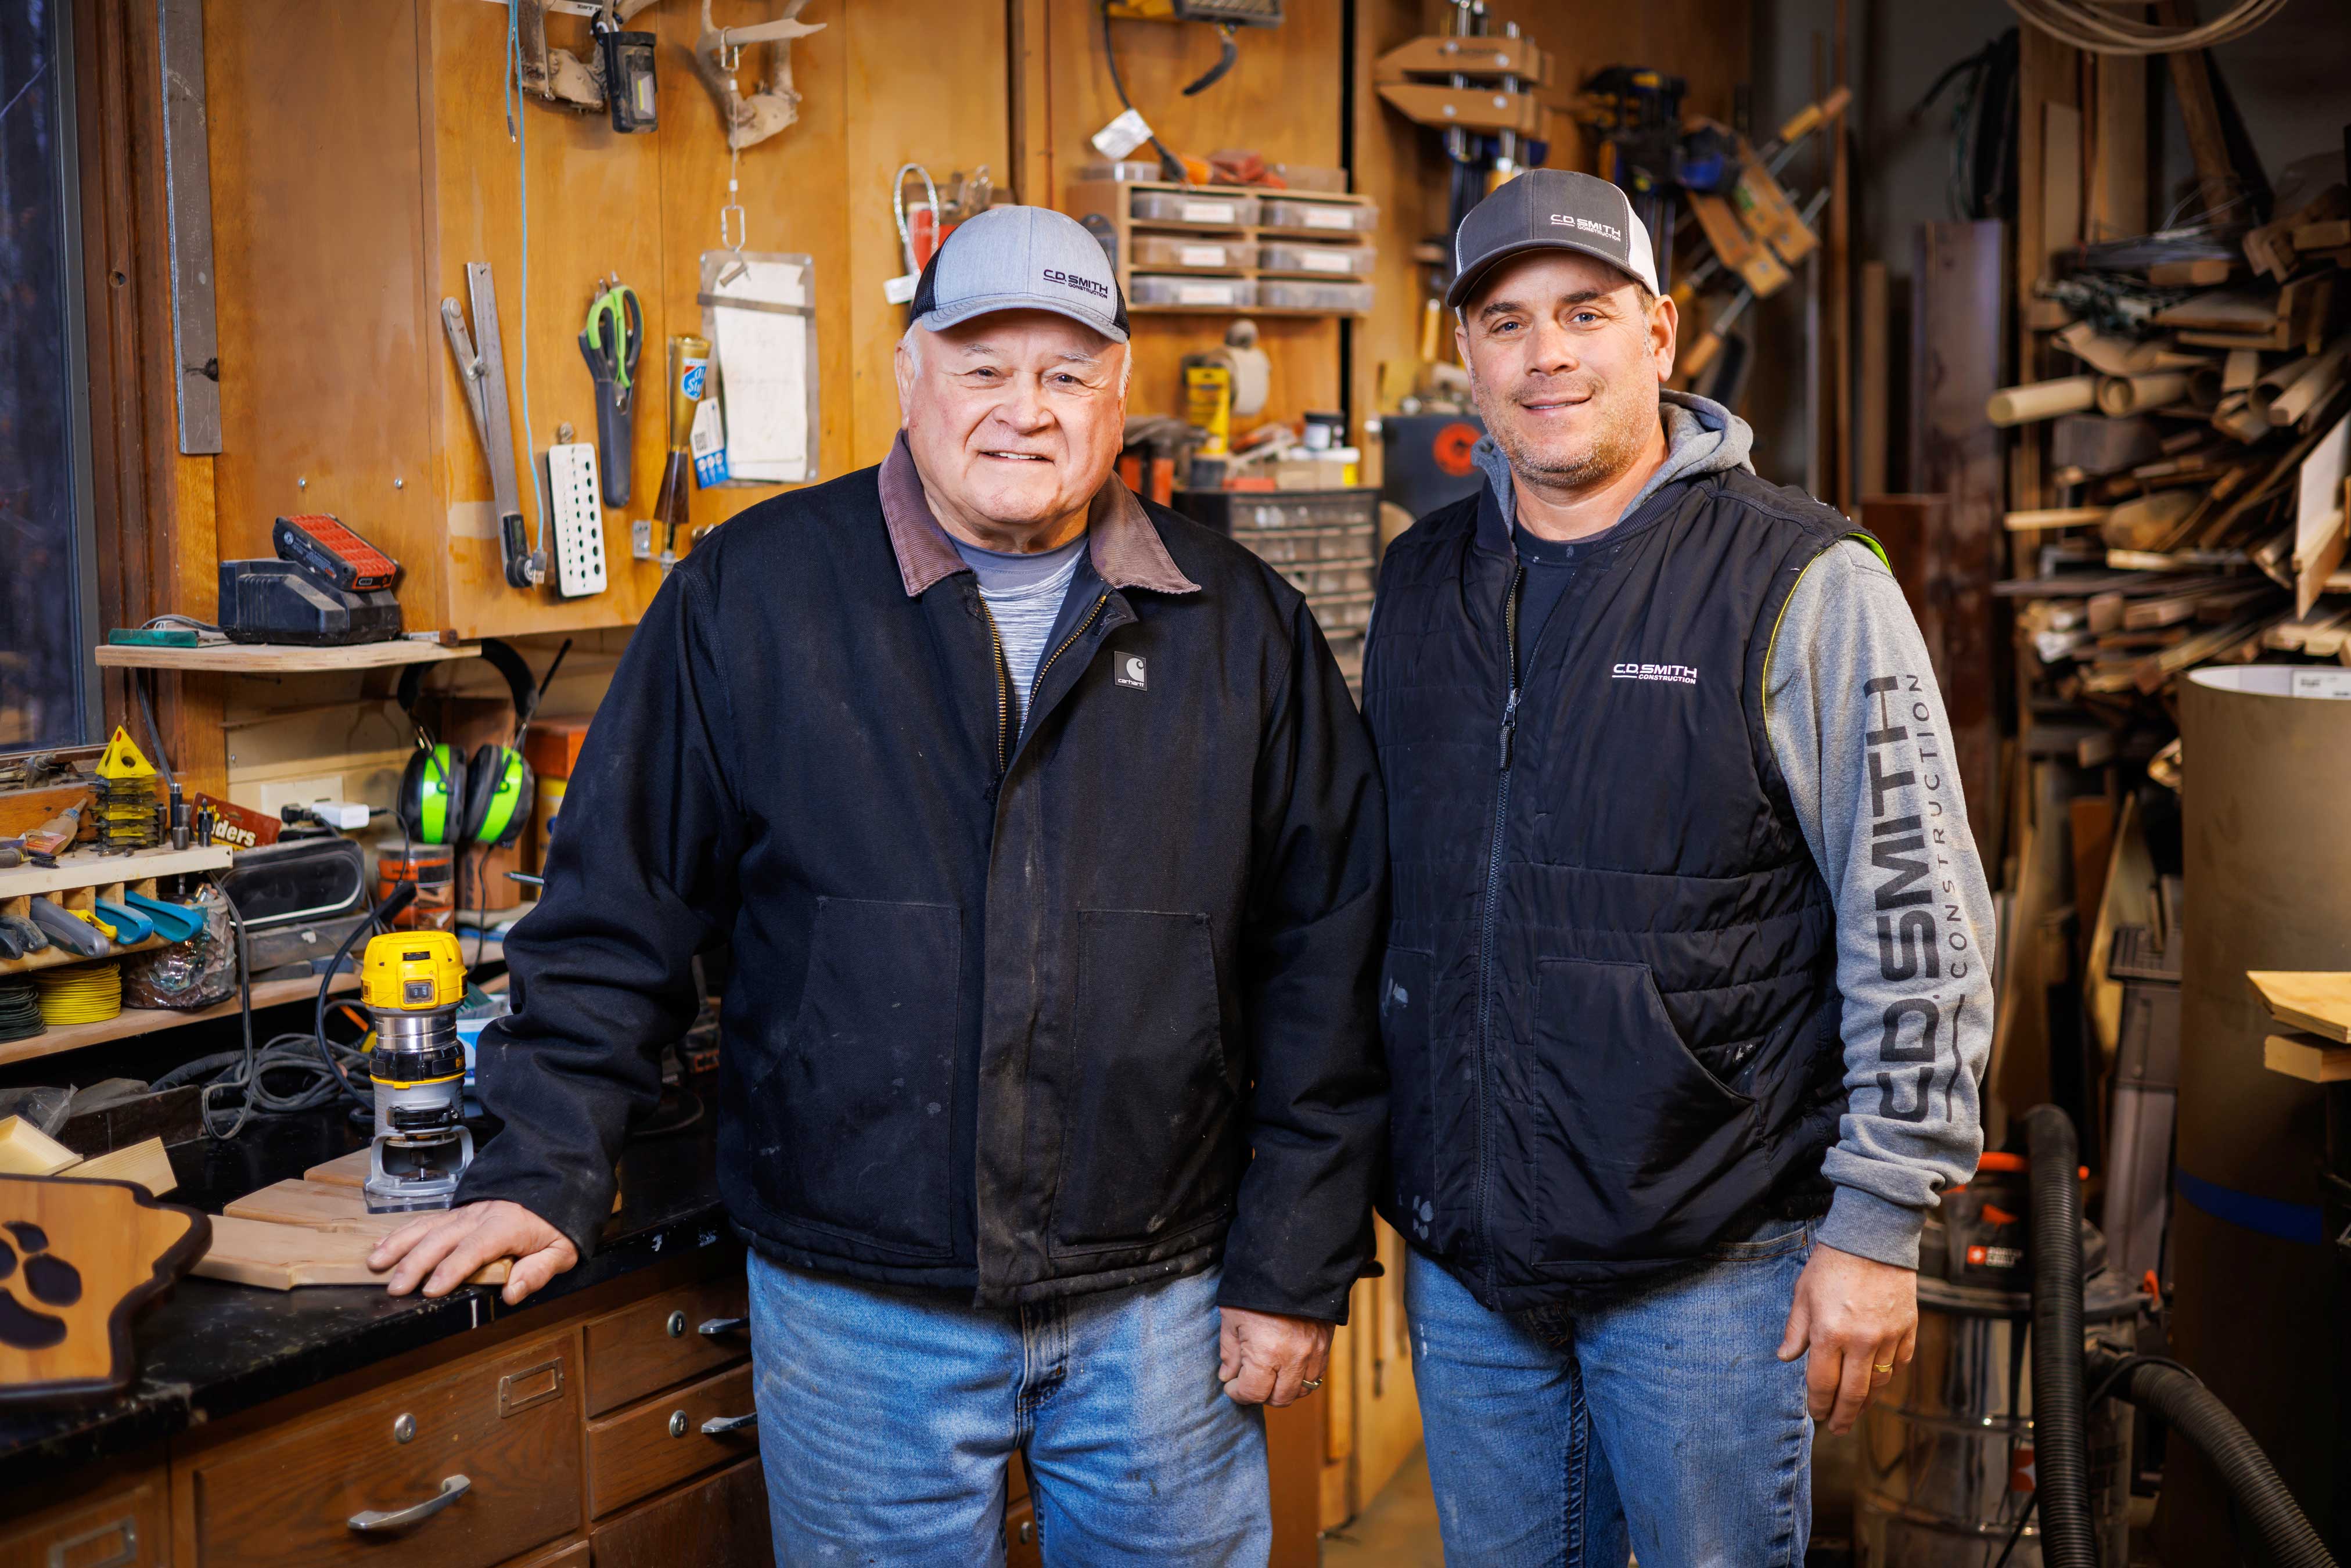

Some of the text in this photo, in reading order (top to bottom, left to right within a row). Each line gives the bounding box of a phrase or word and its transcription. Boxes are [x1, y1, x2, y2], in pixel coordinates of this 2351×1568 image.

[1577, 218, 1621, 238] SMITH
[1577, 225, 1621, 242] CONSTRUCTION
[1068, 274, 1108, 294] SMITH
[1068, 282, 1108, 299] CONSTRUCTION
[1638, 674, 1696, 685] CONSTRUCTION
[1640, 664, 1698, 679] SMITH
[1118, 678, 1144, 687] carhartt
[1863, 675, 1940, 982] SMITH
[1907, 674, 1968, 979] CONSTRUCTION
